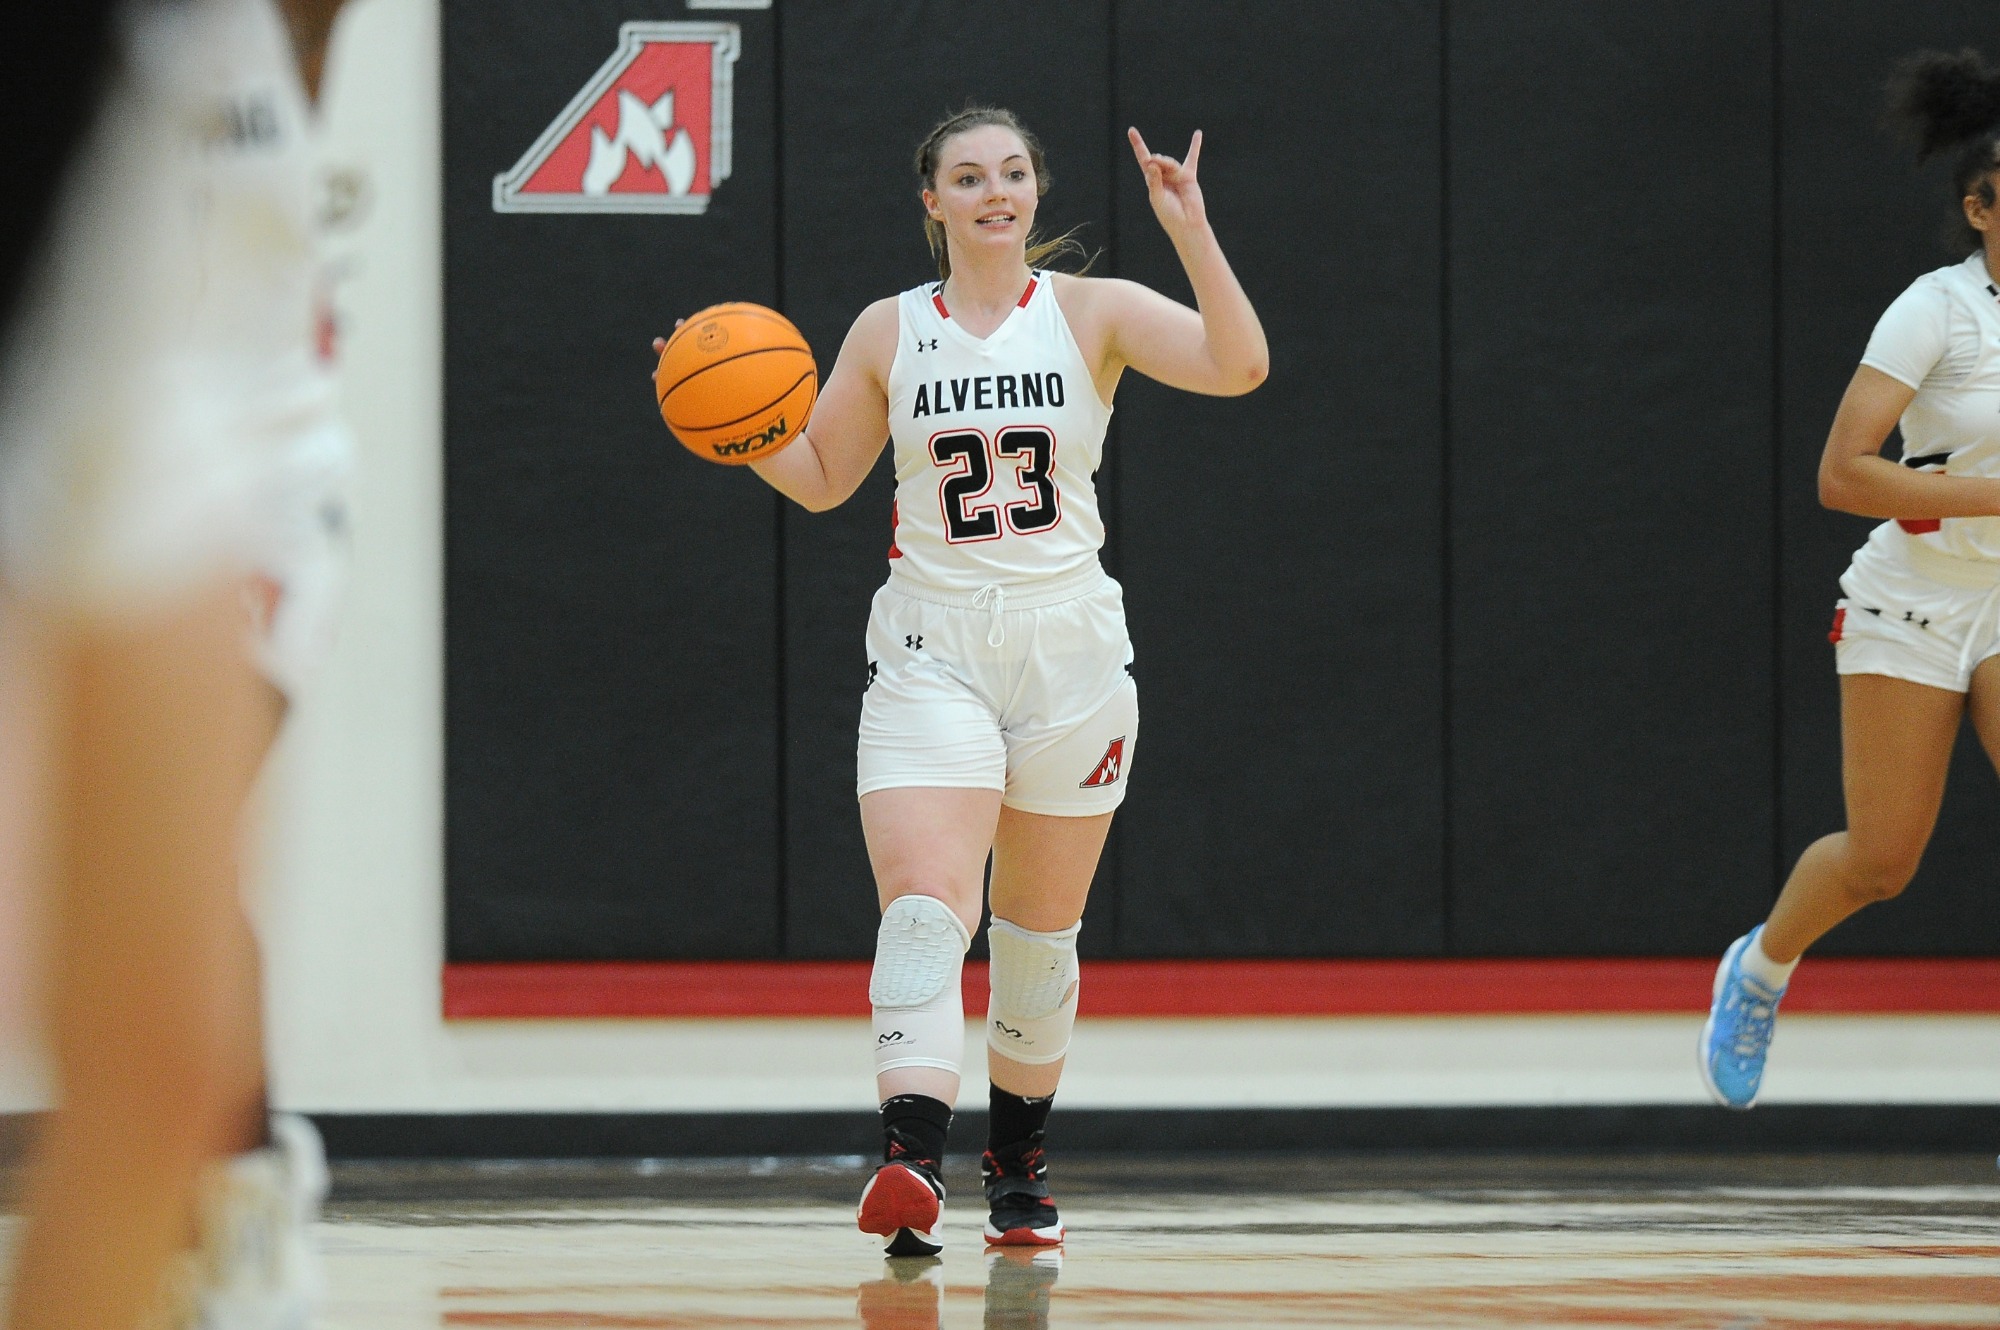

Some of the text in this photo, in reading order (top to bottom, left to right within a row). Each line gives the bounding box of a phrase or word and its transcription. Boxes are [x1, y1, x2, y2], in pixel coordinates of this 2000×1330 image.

[912, 372, 1065, 419] ALVERNO
[712, 417, 788, 456] NCAA
[928, 425, 1062, 545] 23
